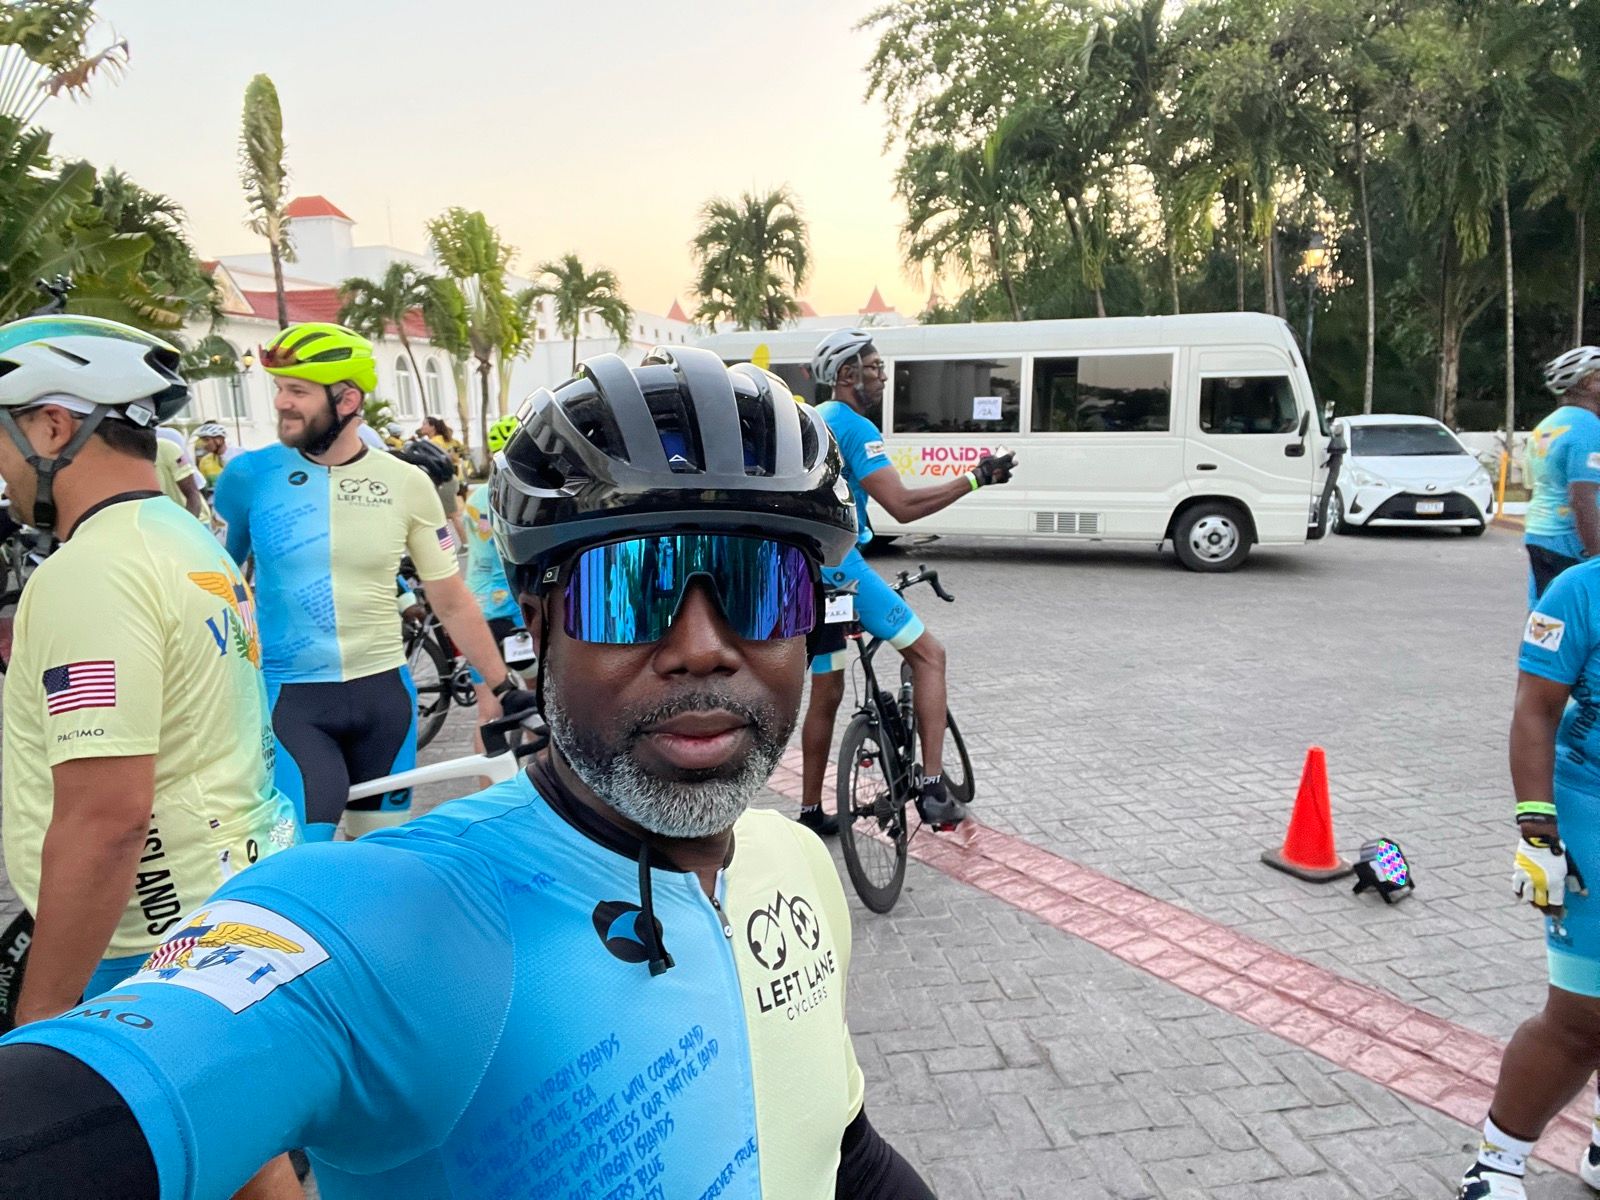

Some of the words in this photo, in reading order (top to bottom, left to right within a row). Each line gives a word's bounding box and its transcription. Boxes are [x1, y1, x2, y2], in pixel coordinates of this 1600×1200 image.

[337, 494, 362, 502] LEFT
[366, 496, 393, 506] LANE
[57, 728, 105, 743] PACIMO
[756, 970, 802, 1013] LEFT
[803, 949, 835, 990] LANE
[786, 985, 828, 1021] CYCLERS
[533, 1062, 578, 1103] VIRGIN
[576, 1032, 620, 1078] ISLANDS
[580, 1092, 620, 1139] BRIGHT
[621, 1073, 648, 1106] WITH
[647, 1047, 681, 1082] CORAL
[678, 1025, 704, 1060] SAND
[546, 1099, 572, 1127] THE
[572, 1082, 600, 1113] SEA
[569, 1135, 608, 1178] WINDS
[606, 1110, 641, 1150] BLESS
[641, 1090, 667, 1120] OUR
[662, 1058, 699, 1101] NATIVE
[697, 1038, 719, 1072] LAND
[593, 1143, 636, 1189] VIRGIN
[633, 1110, 675, 1161] ISLANDS
[734, 1136, 758, 1169] TRUE
[633, 1152, 665, 1193] BLUE
